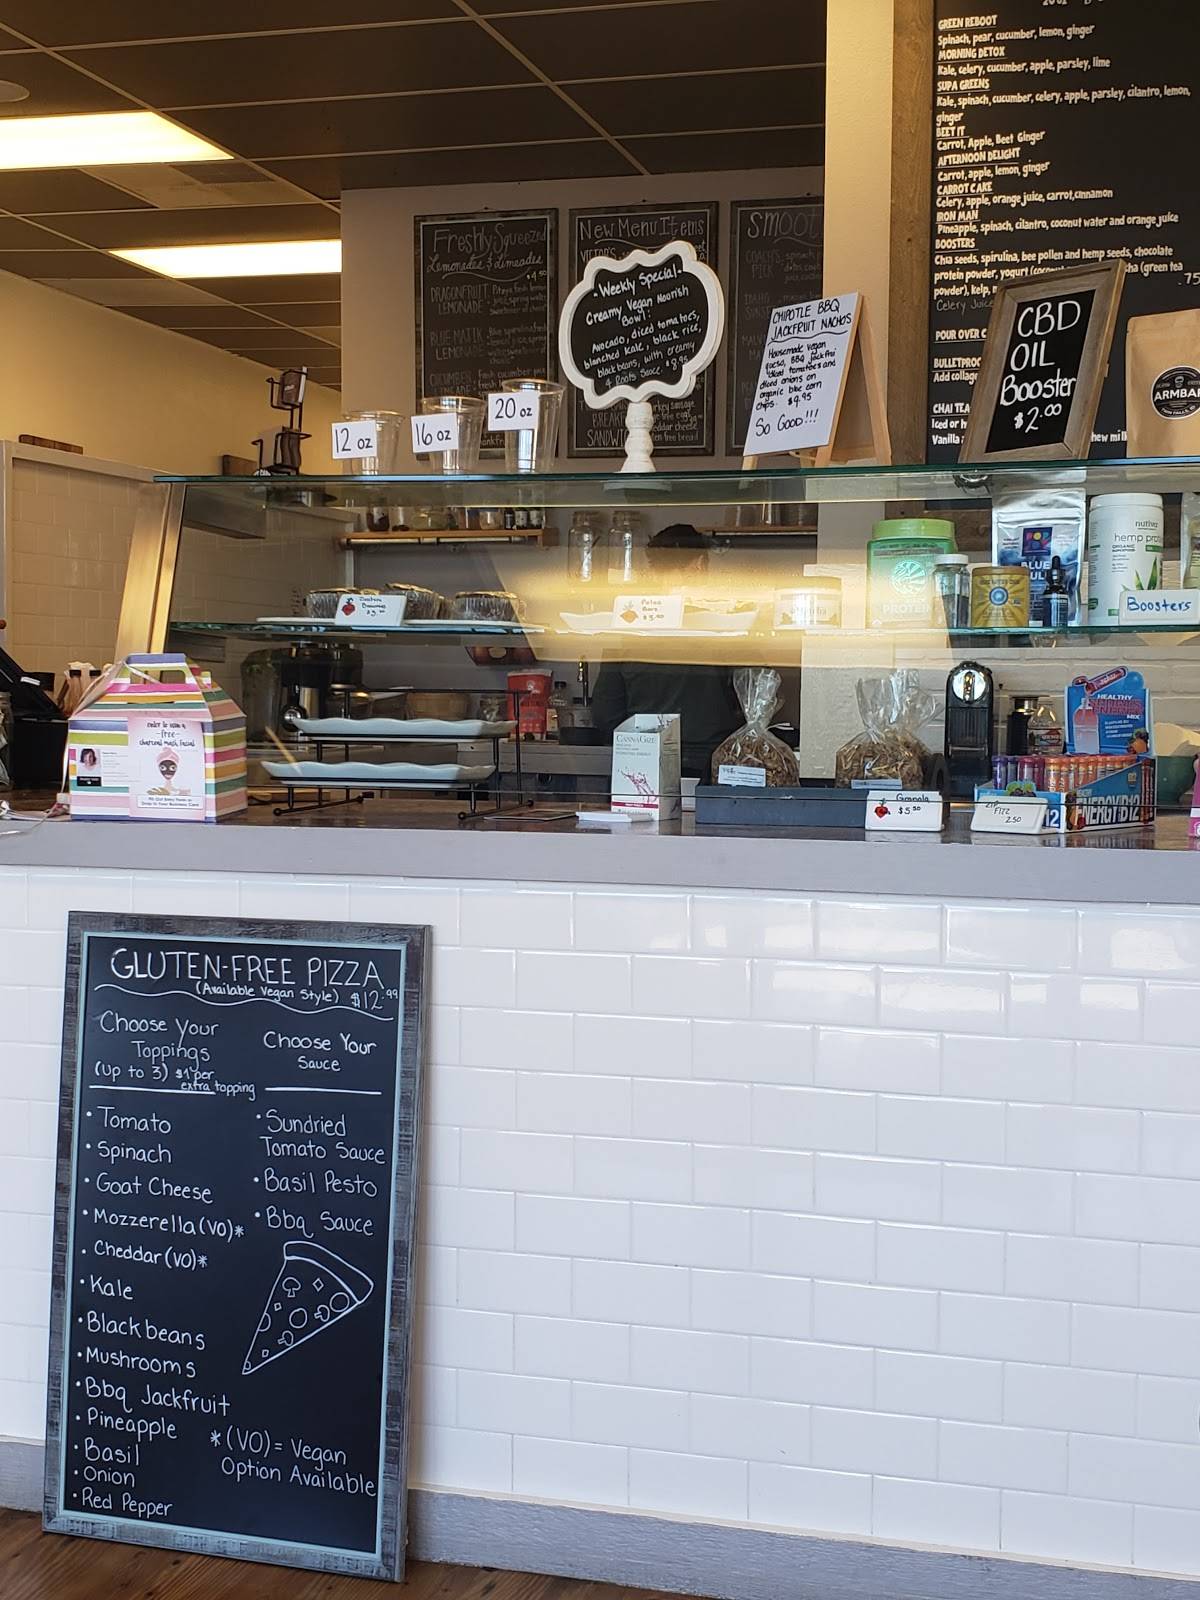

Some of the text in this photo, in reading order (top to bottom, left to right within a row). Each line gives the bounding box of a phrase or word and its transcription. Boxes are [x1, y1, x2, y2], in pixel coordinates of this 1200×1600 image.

[938, 15, 997, 30] GREEN REBOOT
[938, 46, 1005, 61] MORNING DETOX
[937, 79, 990, 91] SUPA GREENS
[936, 112, 963, 127] ginger
[936, 127, 965, 138] BEET IT
[938, 148, 1020, 166] AFTERNOON DELIGHT
[937, 184, 970, 195] CARROT
[937, 210, 978, 221] IRON MAN
[1051, 217, 1082, 228] coconut
[1084, 216, 1107, 226] water
[1109, 215, 1124, 226] and
[1126, 214, 1156, 227] orange
[1157, 212, 1178, 227] juice
[580, 216, 704, 241] New Menu Items
[935, 238, 975, 249] BOOSTERS
[1021, 250, 1036, 261] bee
[1038, 249, 1064, 262] pollen
[1065, 250, 1080, 259] and
[1082, 248, 1105, 261] hemp
[1134, 245, 1173, 257] chocolate
[586, 305, 622, 326] Creamy
[627, 297, 653, 317] Vegan
[772, 305, 811, 324] CHIPOTLE
[818, 298, 840, 314] BBQ
[936, 298, 966, 316] Celery
[771, 313, 852, 340] JACKFRUIT NACHOS
[1017, 300, 1080, 338] CBD
[631, 324, 654, 340] diced
[936, 329, 956, 340] POUR
[958, 329, 979, 340] OVER
[584, 348, 620, 370] blanched
[653, 329, 680, 346] black
[1010, 340, 1055, 371] OIL
[823, 360, 836, 368] and
[781, 375, 803, 384] onions
[807, 373, 816, 381] on
[806, 381, 822, 391] corn
[1000, 368, 1076, 406] Booster
[495, 398, 533, 419] 20 oz
[933, 403, 970, 414] CHAI TEA
[416, 423, 451, 446] 16 oz
[756, 418, 770, 437] So
[932, 419, 947, 429] Iced
[949, 420, 959, 429] or
[335, 427, 373, 453] 12 oz
[932, 434, 960, 445] Vanilla
[1114, 533, 1144, 543] hemp
[1127, 596, 1192, 612] Boosters
[110, 948, 384, 989] GLUTEN-FREE PIZZA
[196, 982, 256, 998] (Available
[260, 986, 295, 1002] Vegan
[299, 988, 340, 1005] Style)
[99, 1010, 219, 1048] Choose Your
[263, 1030, 377, 1056] Choose Your
[131, 1040, 211, 1073] Toppings
[298, 1056, 341, 1072] Sauce
[95, 1061, 121, 1082] (Up
[128, 1066, 145, 1079] to
[152, 1063, 169, 1082] 3)
[180, 1080, 256, 1101] extra topping
[97, 1105, 172, 1135] Tomato
[265, 1109, 346, 1138] Sundried
[97, 1141, 173, 1164] Spinach
[260, 1135, 386, 1165] Tomato Sauce
[96, 1172, 213, 1204] Goat Cheese
[264, 1167, 378, 1198] Basil Pesto
[265, 1205, 375, 1239] Bbq Sauce
[90, 1274, 134, 1300] Kale
[86, 1346, 196, 1378] Mushrooms
[85, 1376, 231, 1417] Bbq Jackfruit
[87, 1406, 178, 1442] Pineapple
[84, 1436, 139, 1466] Basil
[291, 1437, 347, 1472] Vegan
[83, 1465, 135, 1488] Onion
[221, 1456, 377, 1497] Option Available
[82, 1486, 173, 1518] Red Pepper
